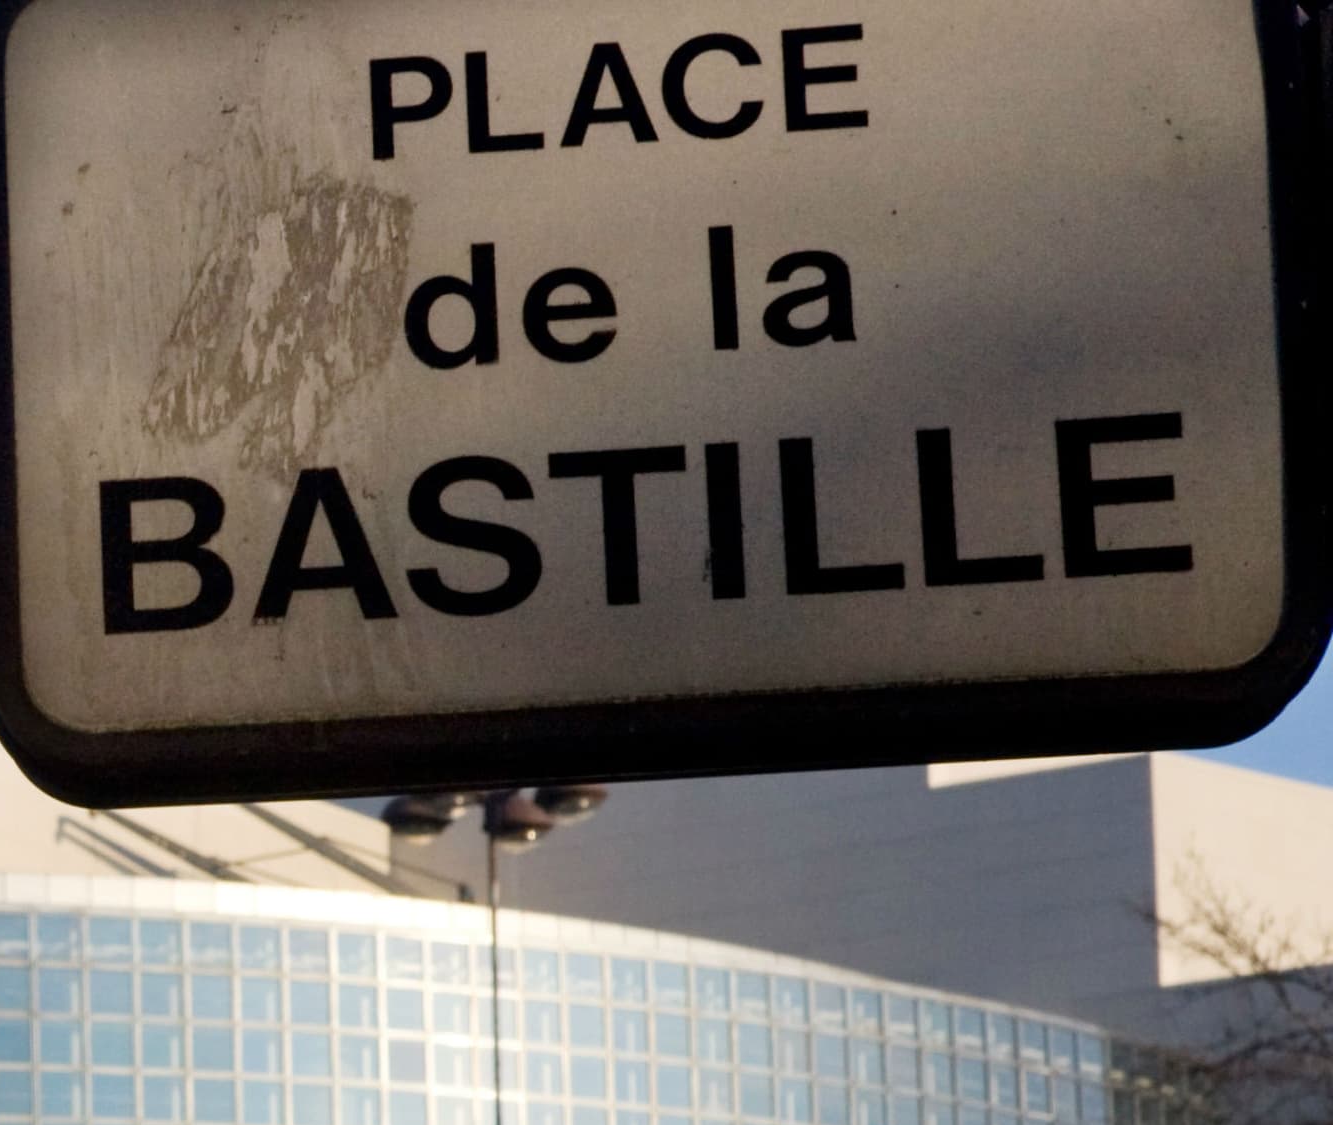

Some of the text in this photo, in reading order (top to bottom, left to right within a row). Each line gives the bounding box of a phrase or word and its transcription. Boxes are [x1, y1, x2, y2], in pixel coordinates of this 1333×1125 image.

[369, 23, 869, 161] PLACE
[403, 225, 858, 371] de la
[99, 410, 1195, 636] BASTILLE
